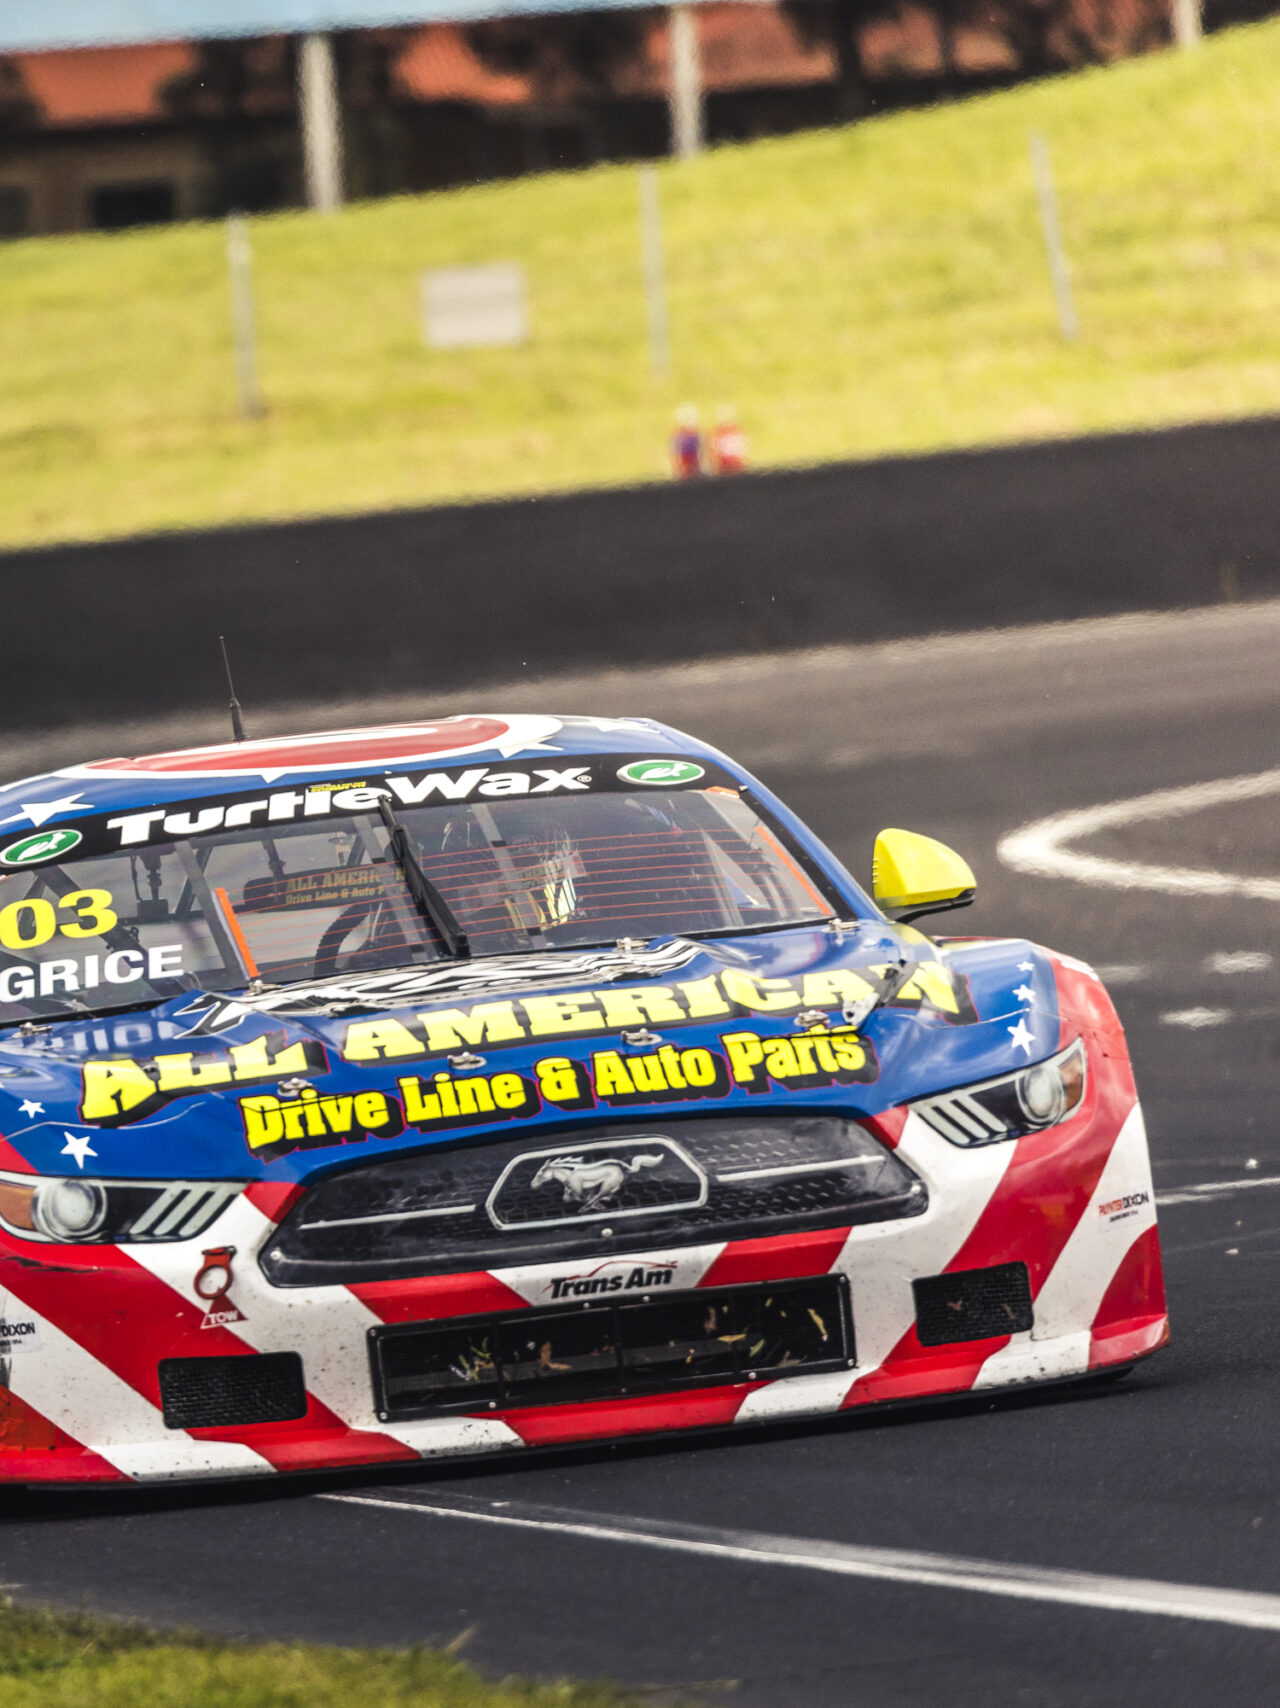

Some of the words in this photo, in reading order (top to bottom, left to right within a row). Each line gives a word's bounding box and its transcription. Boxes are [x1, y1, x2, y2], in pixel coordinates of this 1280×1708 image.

[107, 766, 591, 845] TurtleWax
[80, 1033, 310, 1121] ALL
[342, 961, 960, 1063] AMERICAN
[239, 1087, 391, 1152] Drive
[398, 1071, 527, 1125] Line
[533, 1056, 581, 1103] &
[591, 1042, 718, 1098] Auto
[721, 1023, 868, 1084] Parts
[206, 1309, 239, 1325] TOW
[550, 1274, 624, 1299] Trans
[623, 1267, 674, 1290] Am
